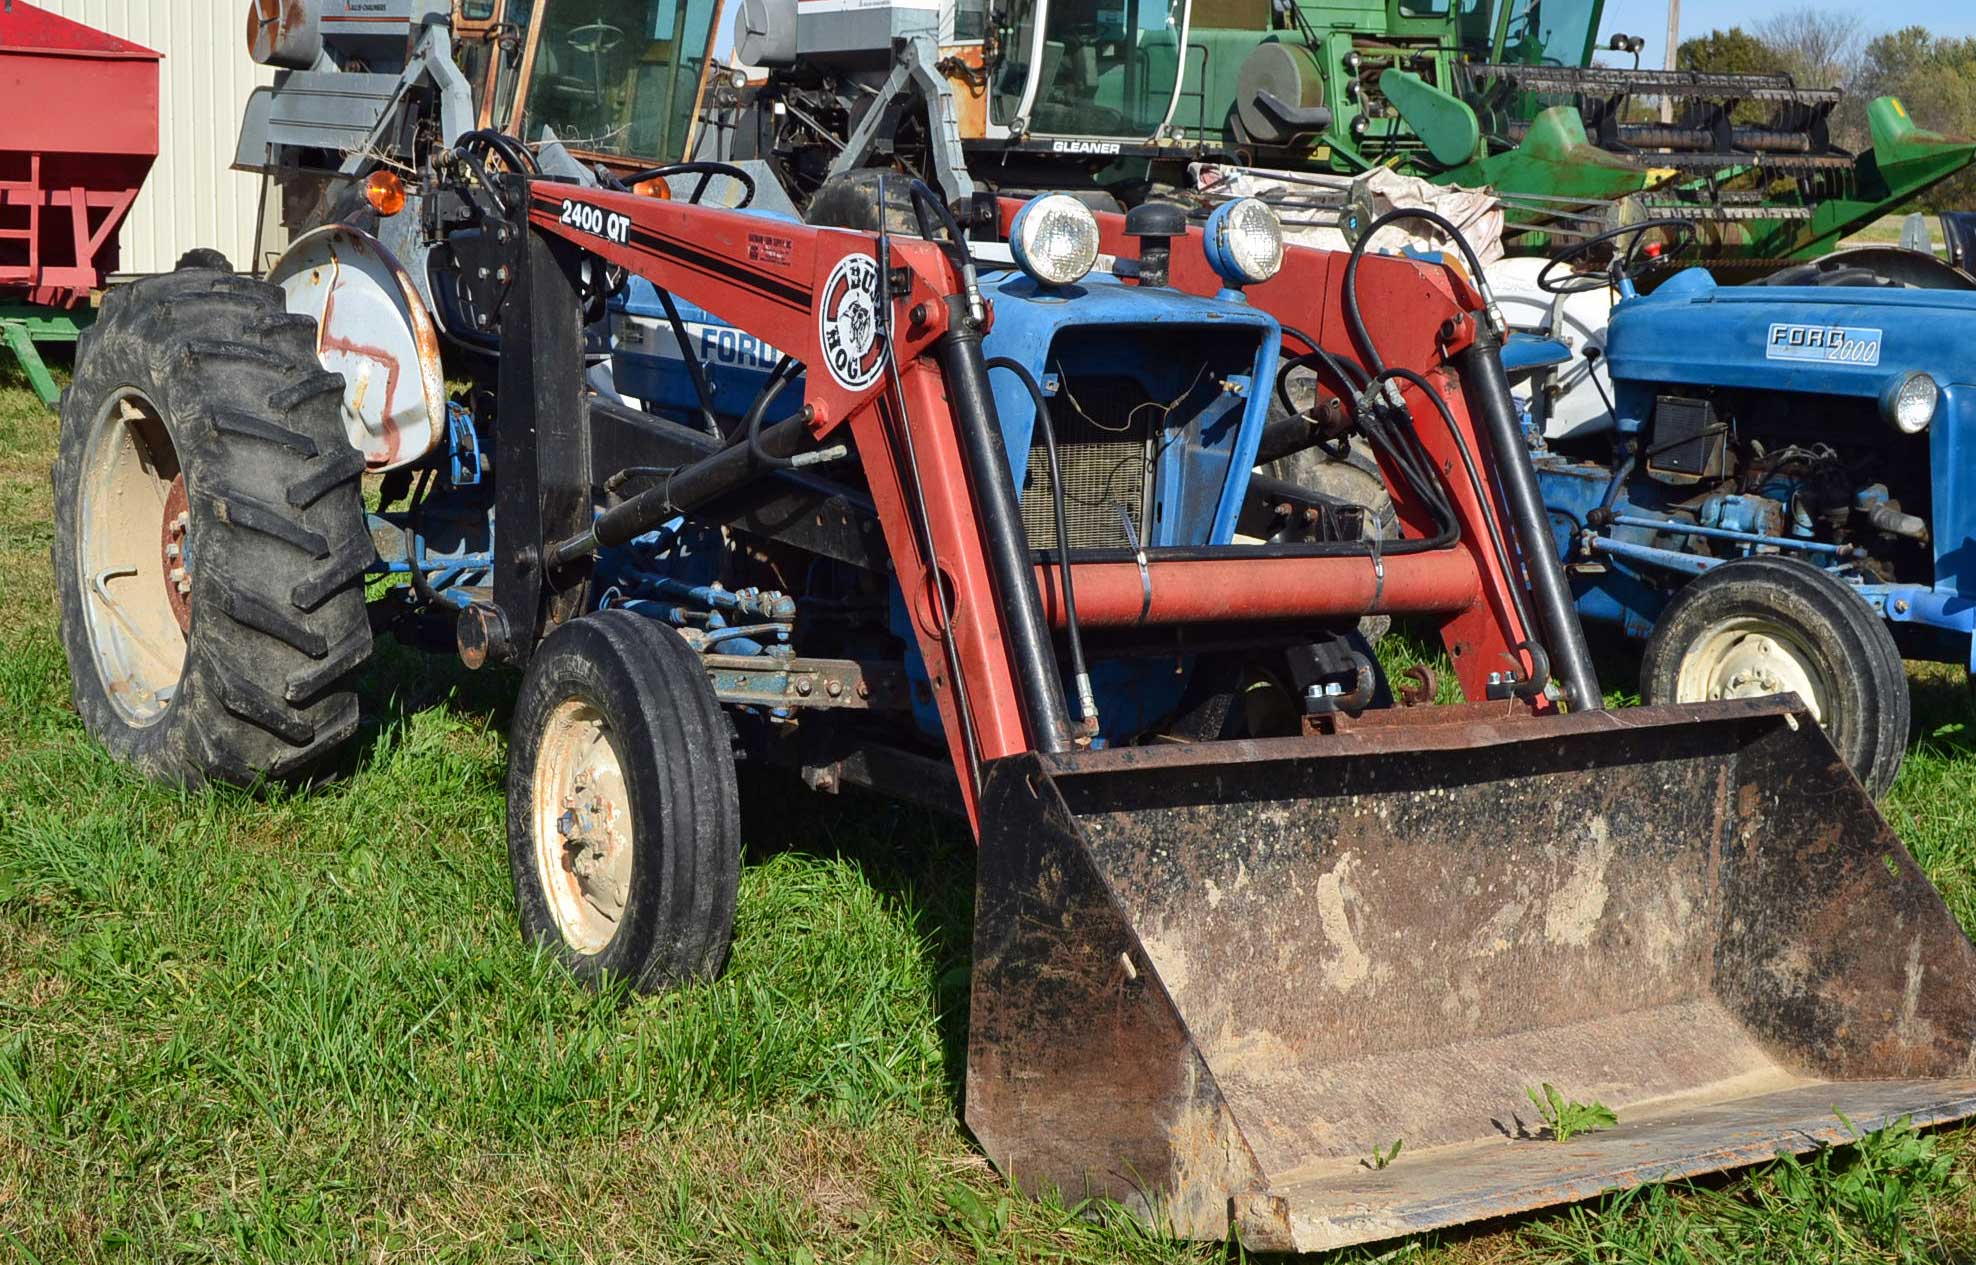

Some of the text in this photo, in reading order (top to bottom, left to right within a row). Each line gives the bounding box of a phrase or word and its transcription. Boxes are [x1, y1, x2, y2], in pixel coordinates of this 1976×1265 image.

[1053, 141, 1120, 154] GLEANER
[562, 199, 630, 242] 2400 QT
[701, 327, 777, 369] FORD
[826, 325, 858, 380] HOG
[1771, 326, 1877, 361] FORD 2000
